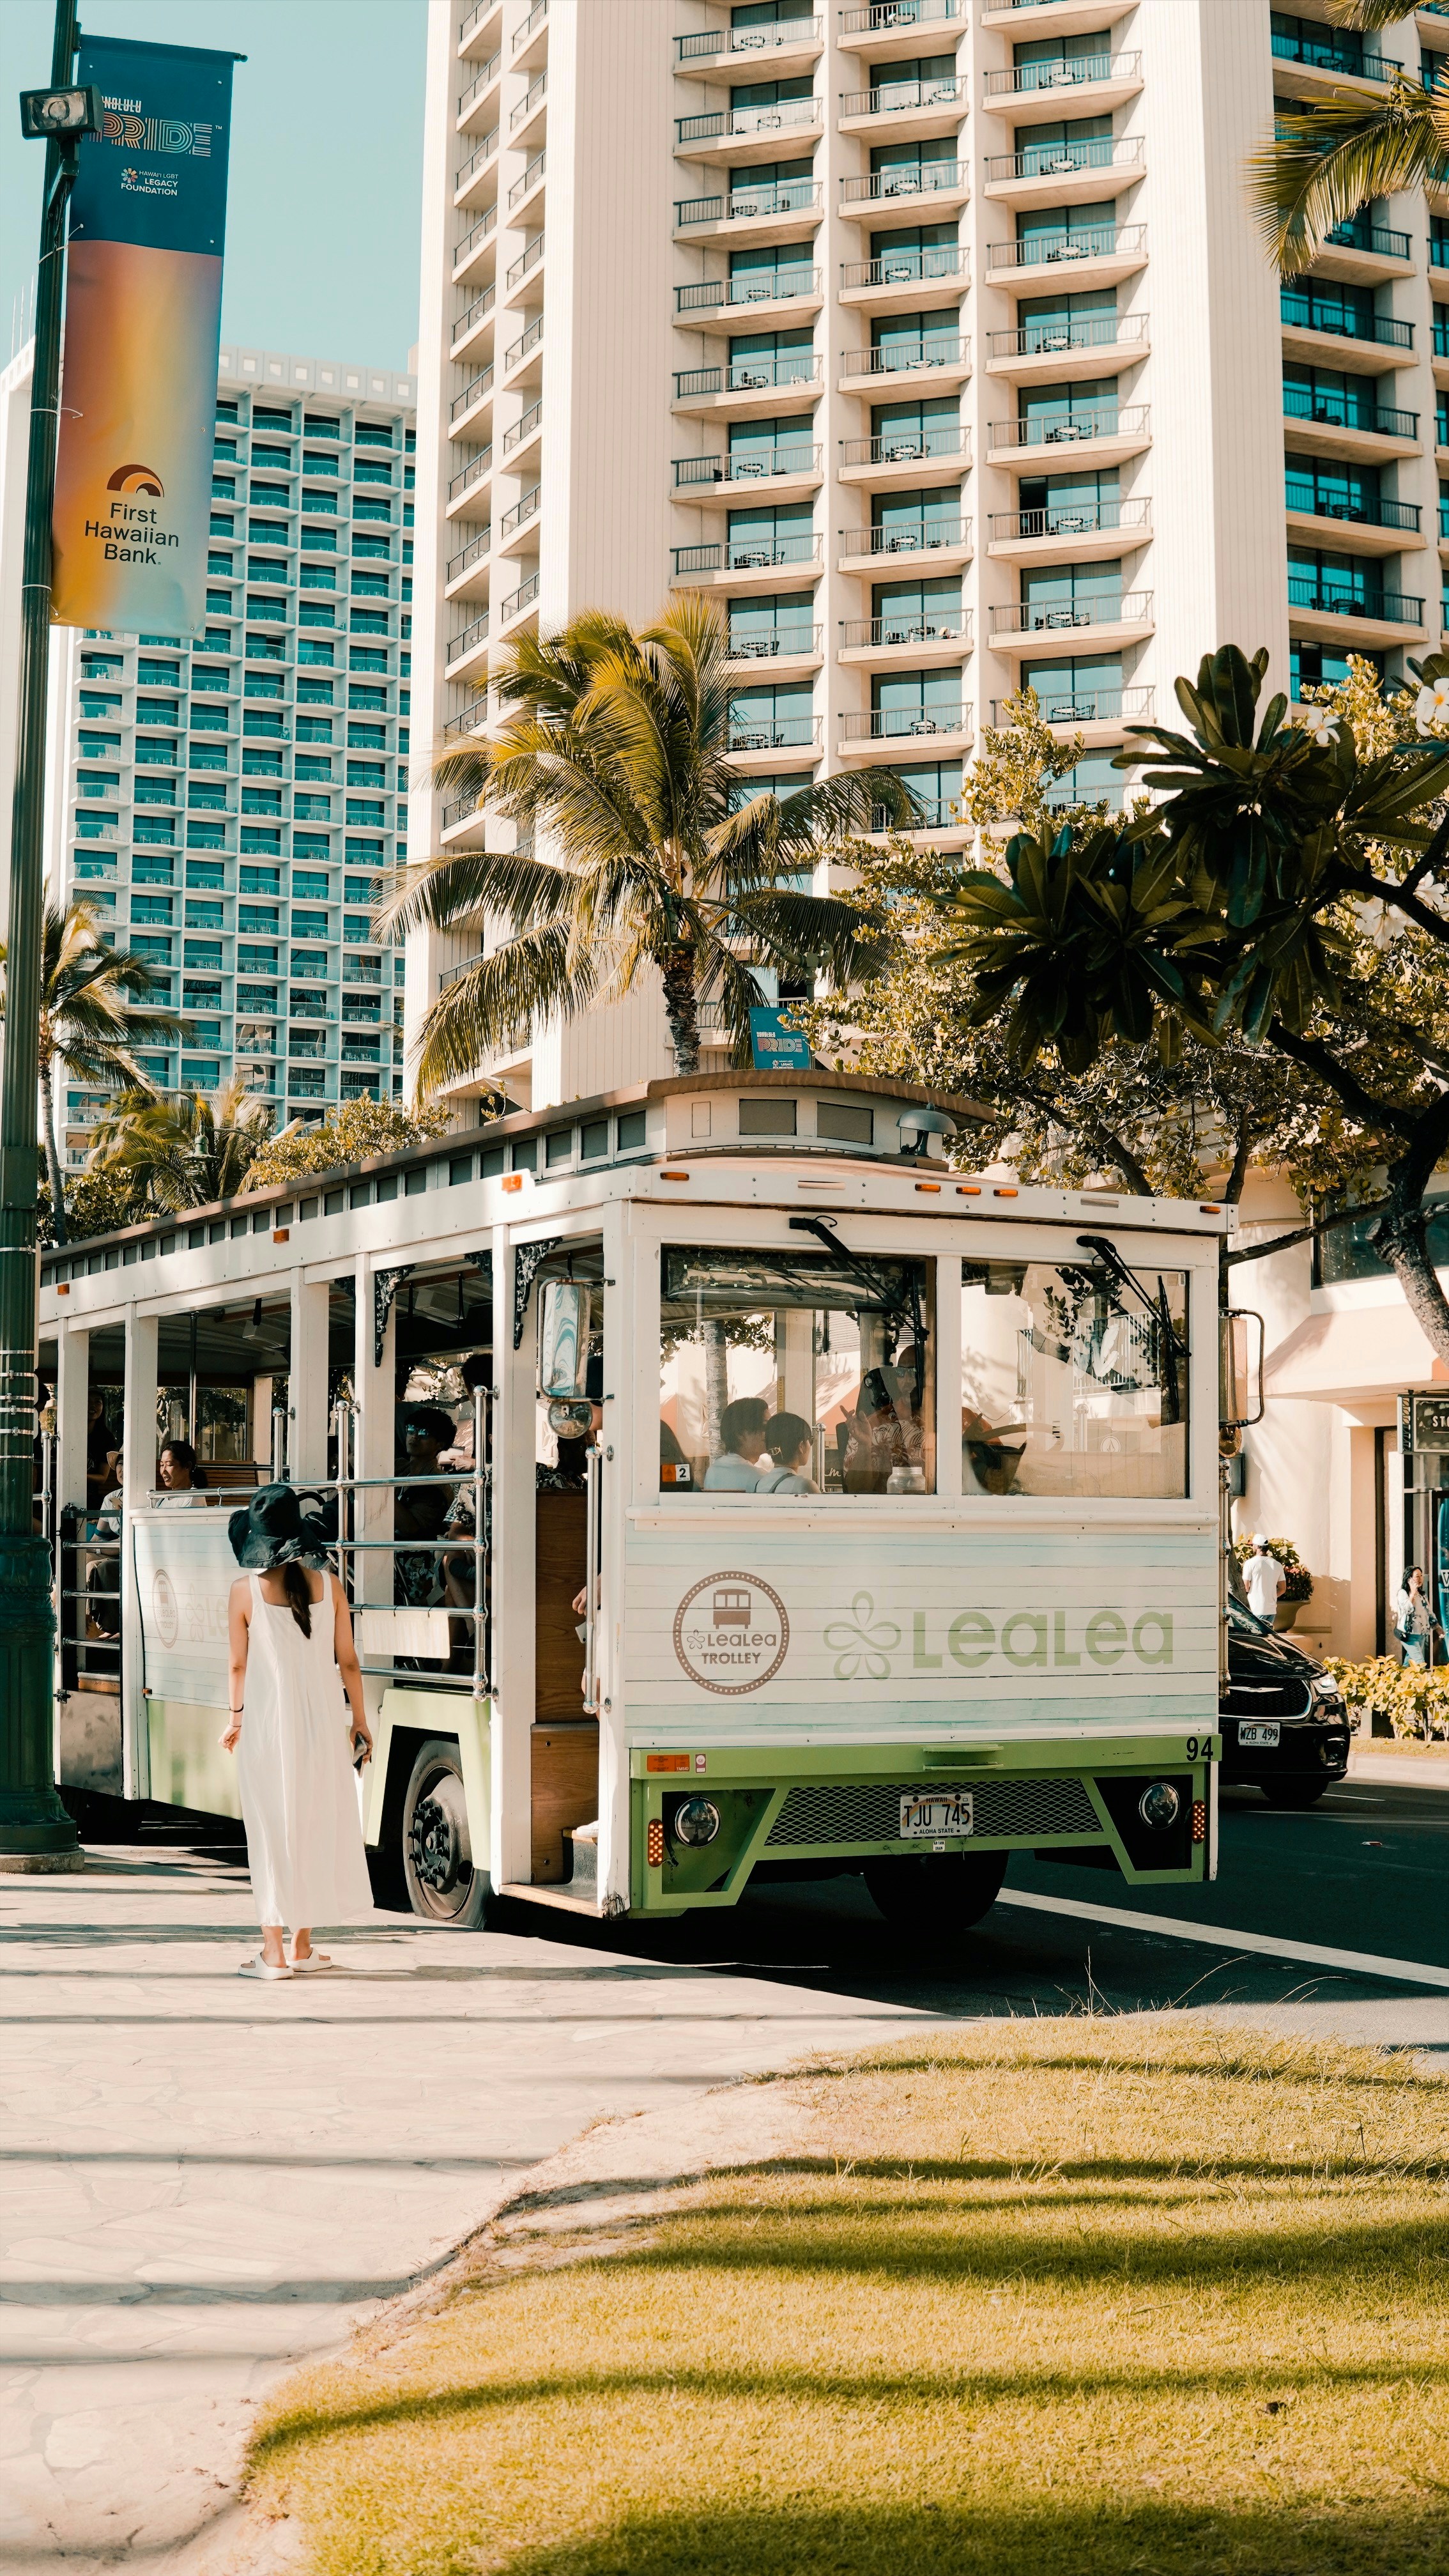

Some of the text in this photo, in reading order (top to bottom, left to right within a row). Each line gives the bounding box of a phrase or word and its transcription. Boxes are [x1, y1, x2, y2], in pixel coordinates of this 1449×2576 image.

[102, 96, 142, 113] NOLULU
[89, 111, 213, 157] PRIDE
[121, 183, 178, 196] FOUNDATION
[144, 178, 178, 187] LEGACY
[111, 502, 157, 524] First
[85, 520, 179, 548] Hawaiian
[104, 543, 157, 565] Bank
[758, 1038, 803, 1053] PRIDE
[679, 1468, 686, 1477] 2
[702, 1652, 762, 1665] TROLLEY
[1240, 1727, 1278, 1741] WZB 499
[1186, 1736, 1213, 1761] 94
[904, 1803, 970, 1828] TJU 745
